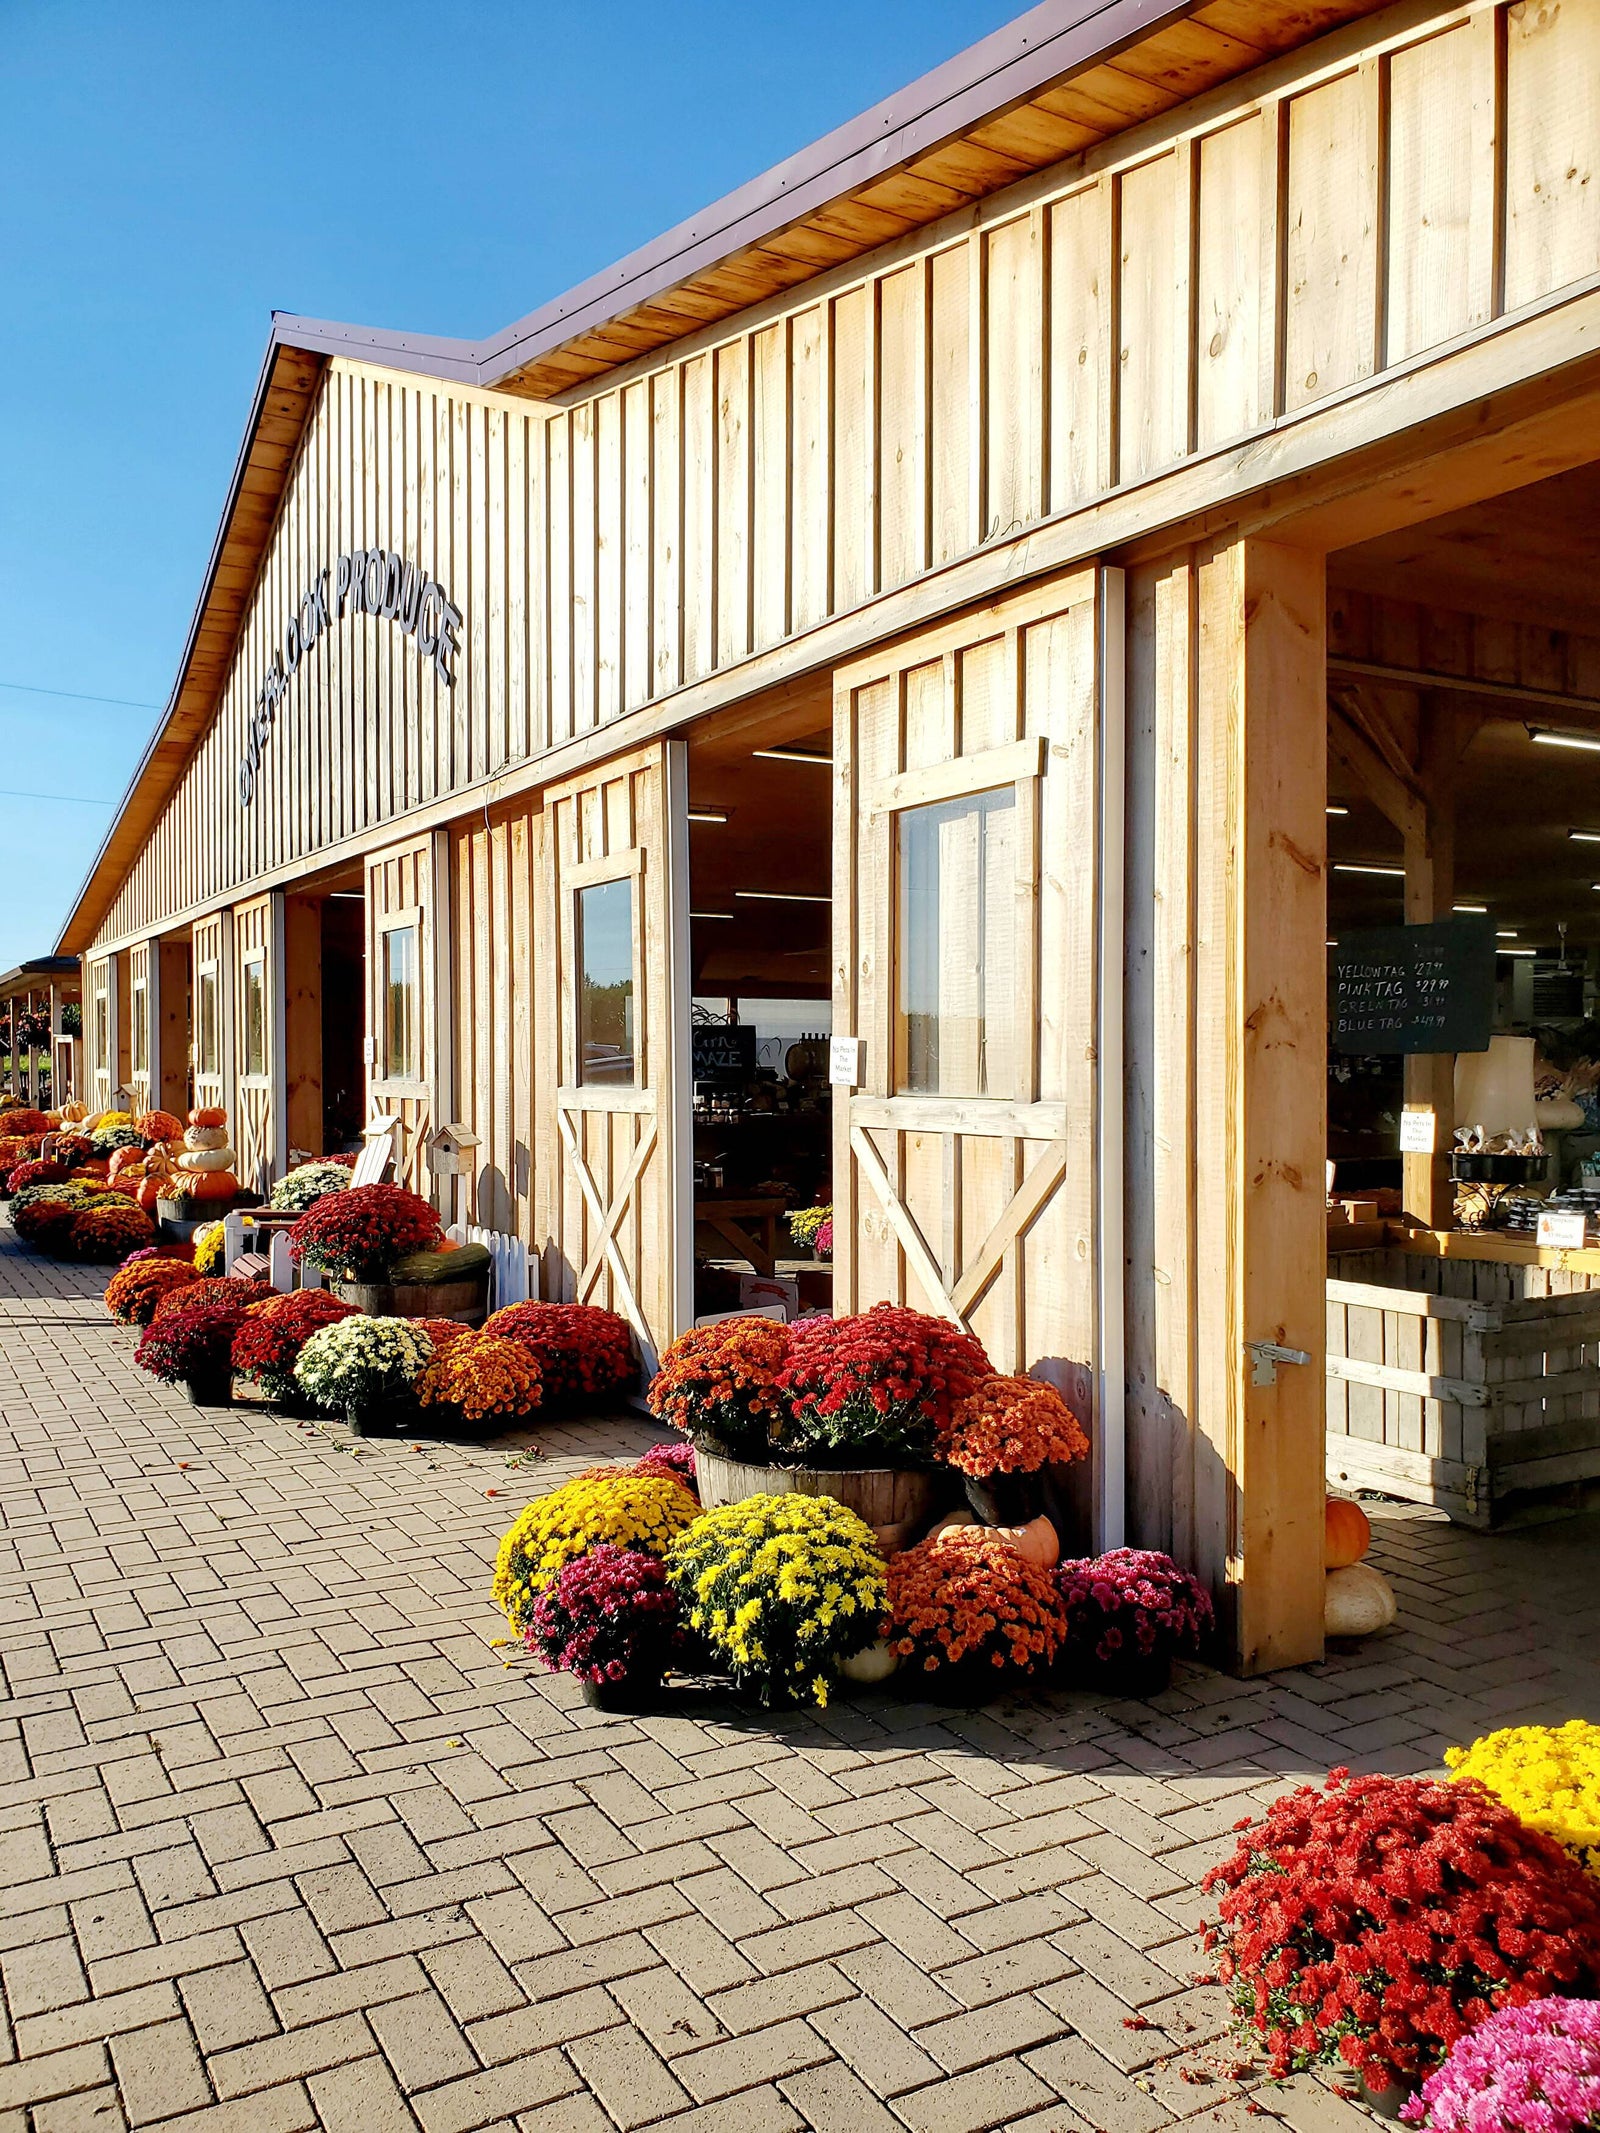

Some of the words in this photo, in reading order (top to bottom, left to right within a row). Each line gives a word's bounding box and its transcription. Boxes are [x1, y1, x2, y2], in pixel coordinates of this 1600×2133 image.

[239, 567, 332, 807] OVERLOOK
[336, 547, 463, 687] PRODUCE
[1338, 965, 1381, 978] YELLOW
[1384, 966, 1405, 977] TAG
[1338, 982, 1372, 995] PINK
[1375, 981, 1403, 996] TAG
[1387, 998, 1408, 1010] TAG
[1338, 1019, 1374, 1032] BLUE
[1380, 1017, 1403, 1030] TAG
[693, 1051, 742, 1067] MAZE
